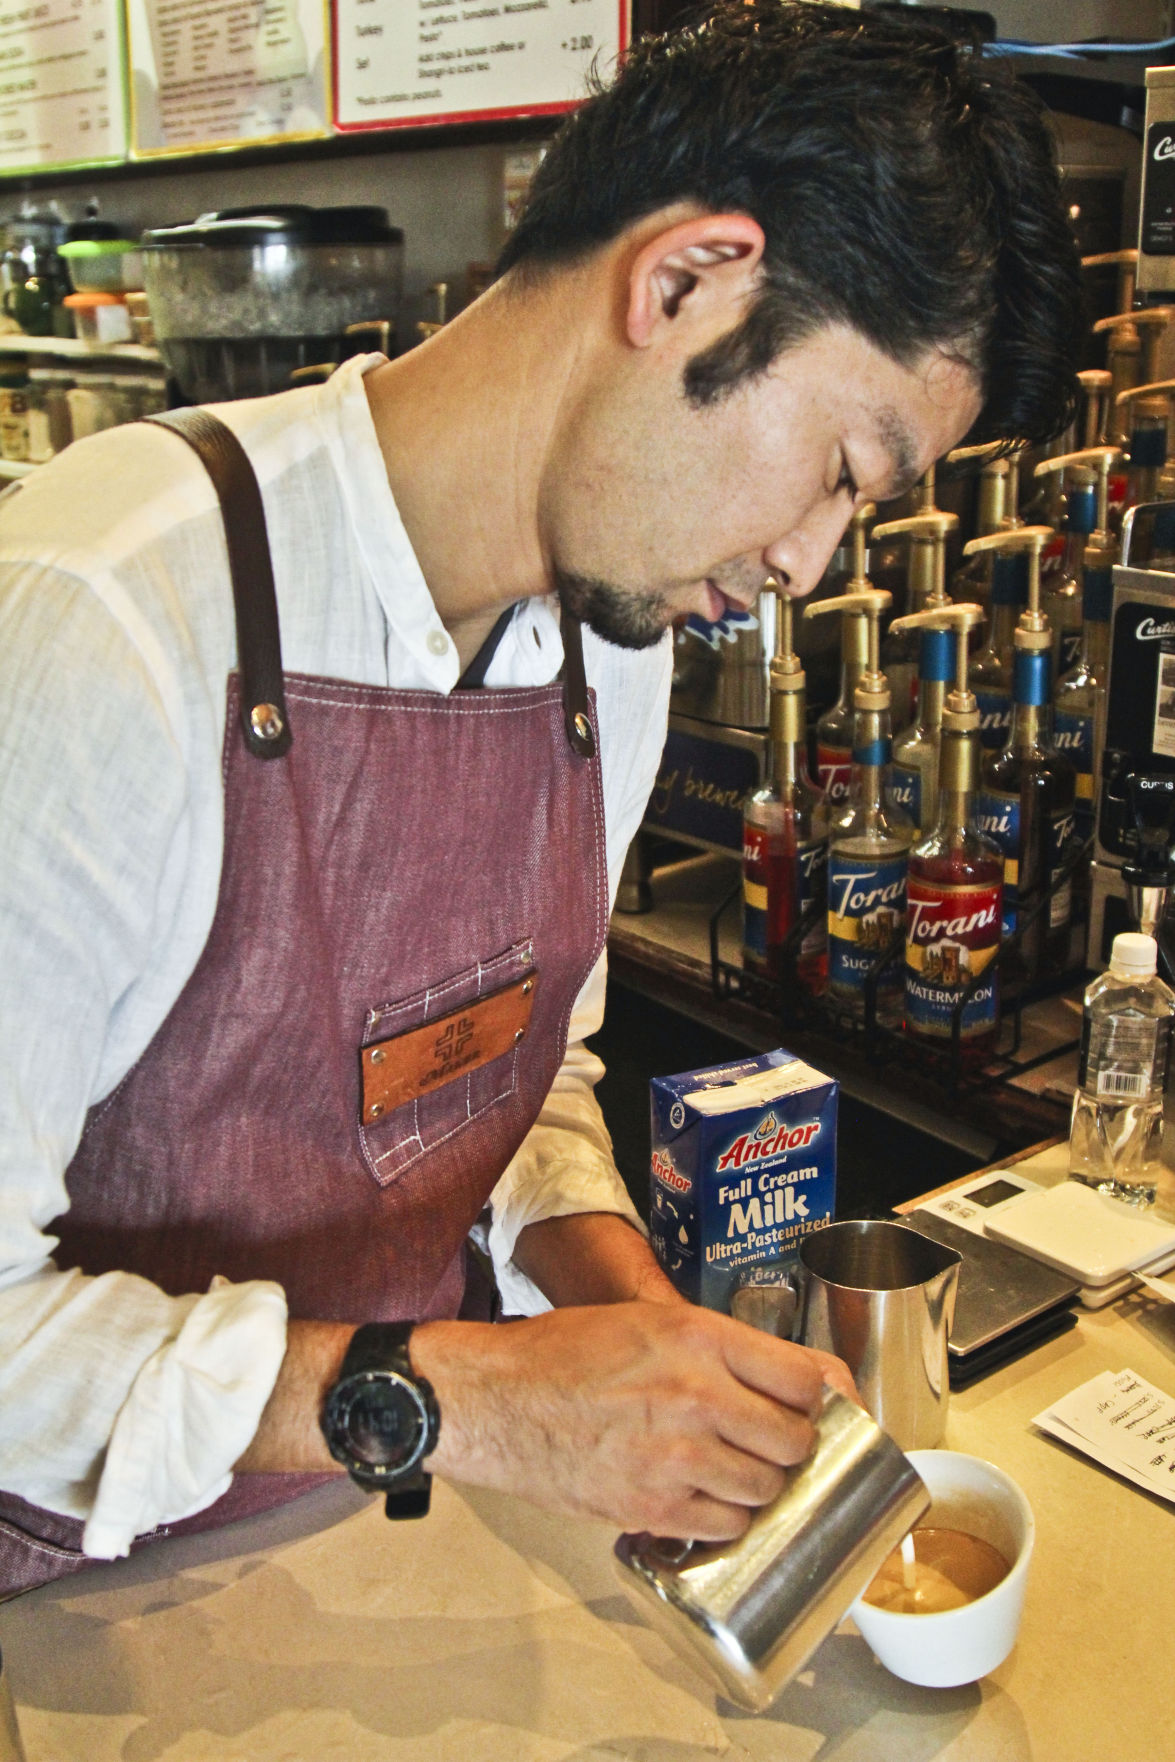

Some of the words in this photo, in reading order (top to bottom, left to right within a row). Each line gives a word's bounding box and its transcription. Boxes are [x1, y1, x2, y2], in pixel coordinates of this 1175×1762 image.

[832, 870, 906, 920] Tora
[907, 895, 997, 945] Torani
[905, 977, 993, 1005] WATERMON
[717, 1122, 821, 1172] Anchor
[744, 1164, 760, 1174] New
[762, 1155, 788, 1171] Zealand
[718, 1178, 752, 1205] Full
[758, 1166, 819, 1193] Cream
[705, 1211, 831, 1263] Ultra-Pasteurized
[727, 1186, 810, 1238] Milk
[728, 1251, 766, 1268] vitamin
[769, 1245, 776, 1256] A
[778, 1240, 797, 1253] and
